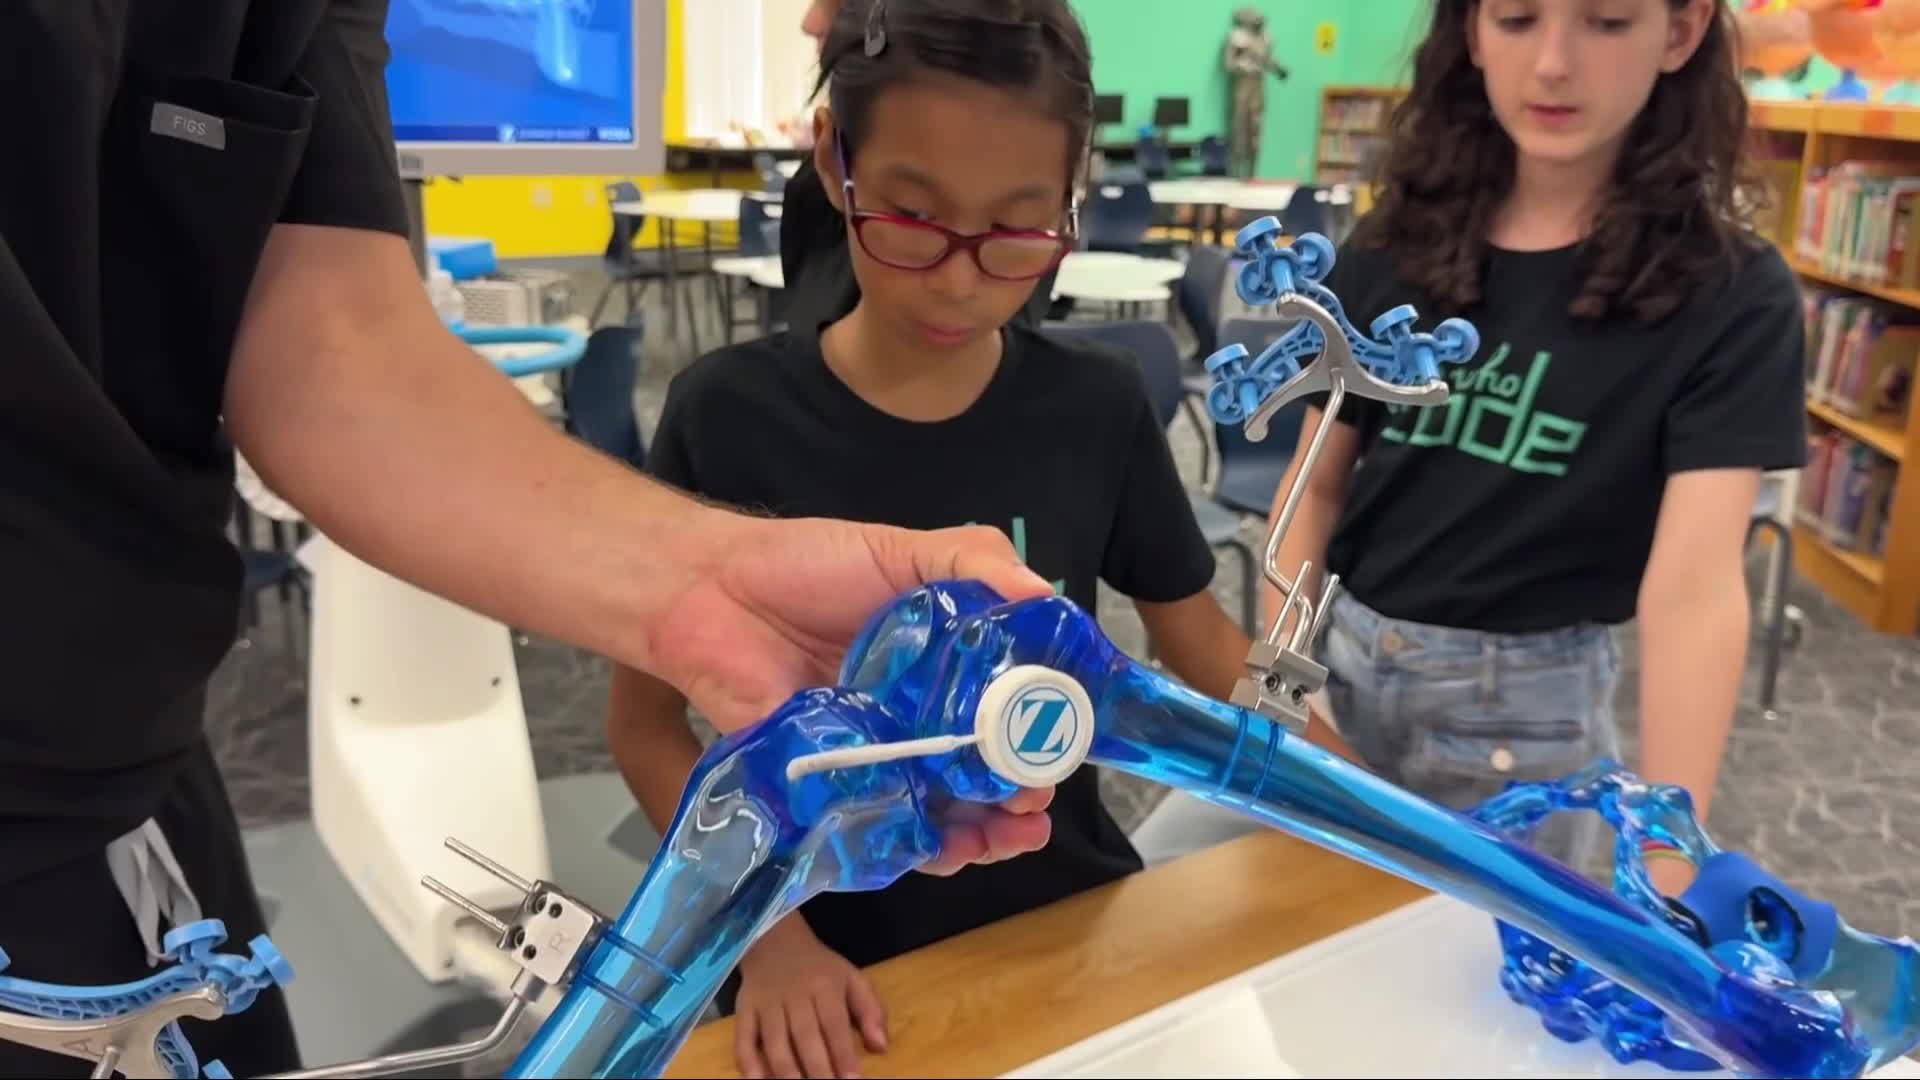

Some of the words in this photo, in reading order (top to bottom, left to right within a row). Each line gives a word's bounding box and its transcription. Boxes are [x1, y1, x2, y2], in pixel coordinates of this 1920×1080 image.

[173, 115, 209, 136] FIGS
[1381, 350, 1588, 477] ode
[1015, 698, 1069, 753] Z
